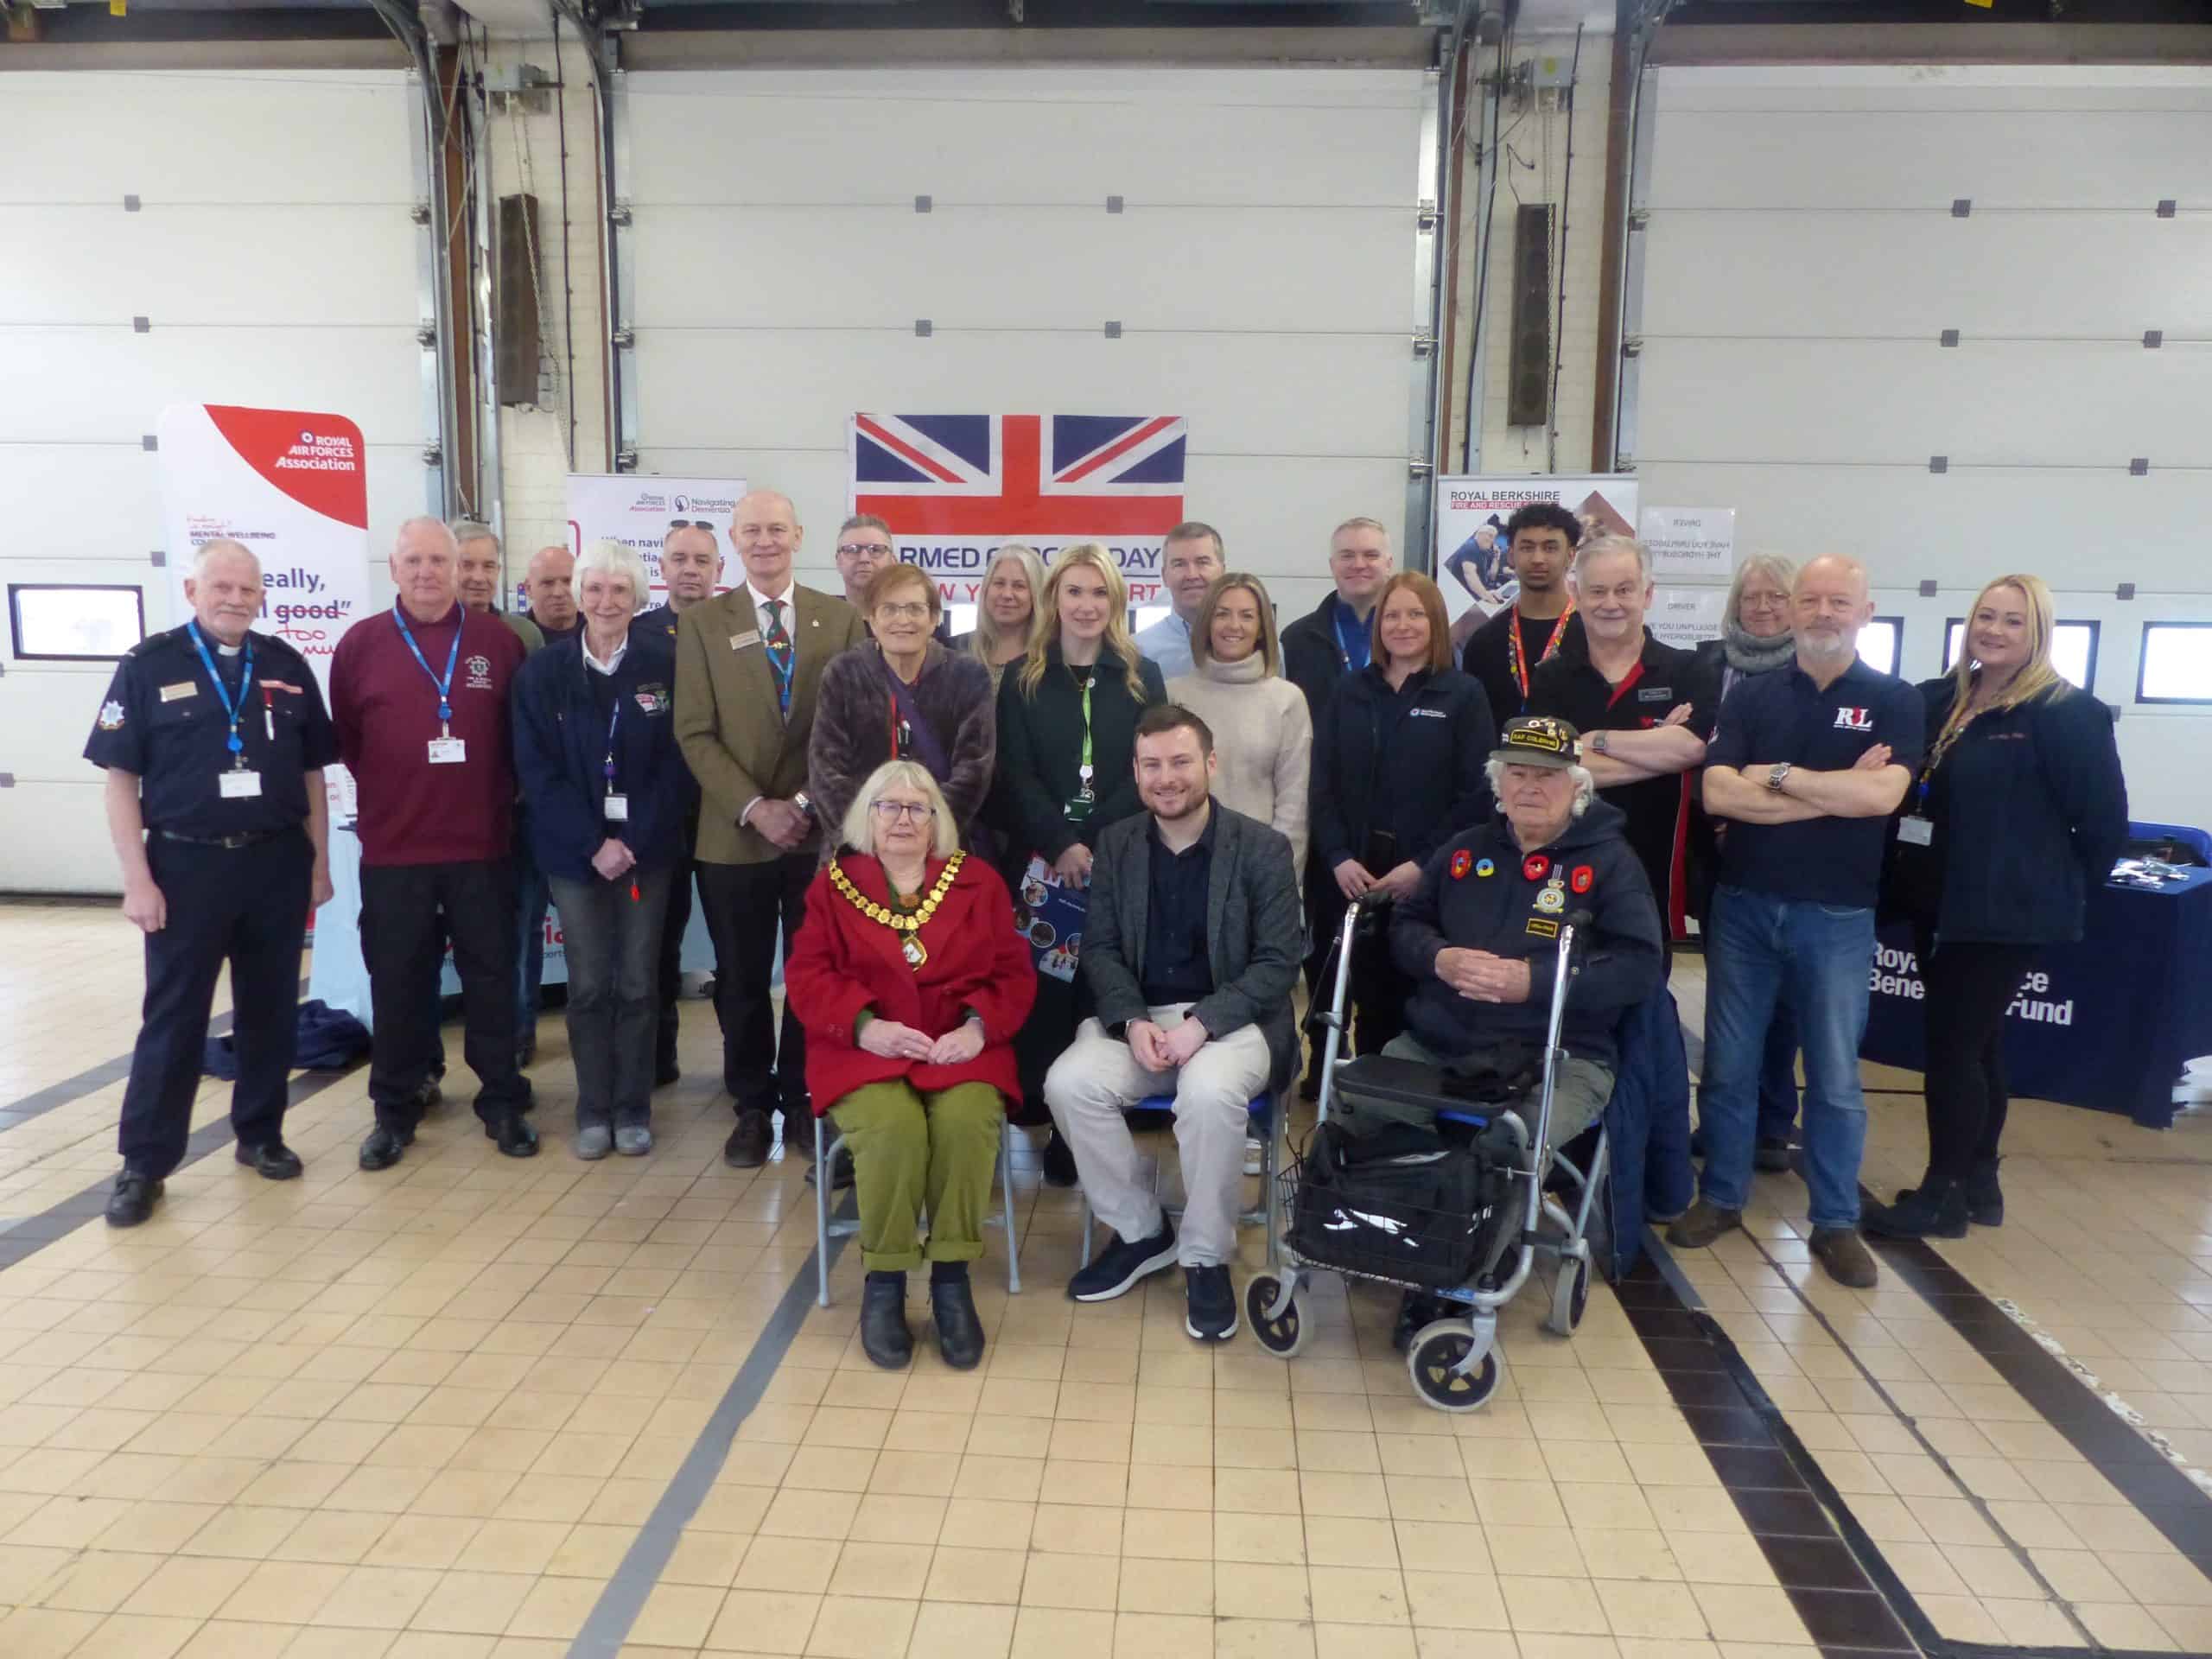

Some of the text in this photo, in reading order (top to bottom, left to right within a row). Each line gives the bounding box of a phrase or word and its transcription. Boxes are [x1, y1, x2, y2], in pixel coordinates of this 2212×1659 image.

[316, 436, 353, 447] ROYAL
[289, 445, 354, 457] AIR FORCES
[276, 457, 355, 470] Association
[1451, 492, 1560, 501] ROYAL BERKSHIRE
[691, 498, 736, 509] Navigating
[899, 547, 980, 568] RMED
[262, 567, 326, 594] eally,
[1869, 968, 1926, 1000] Bene
